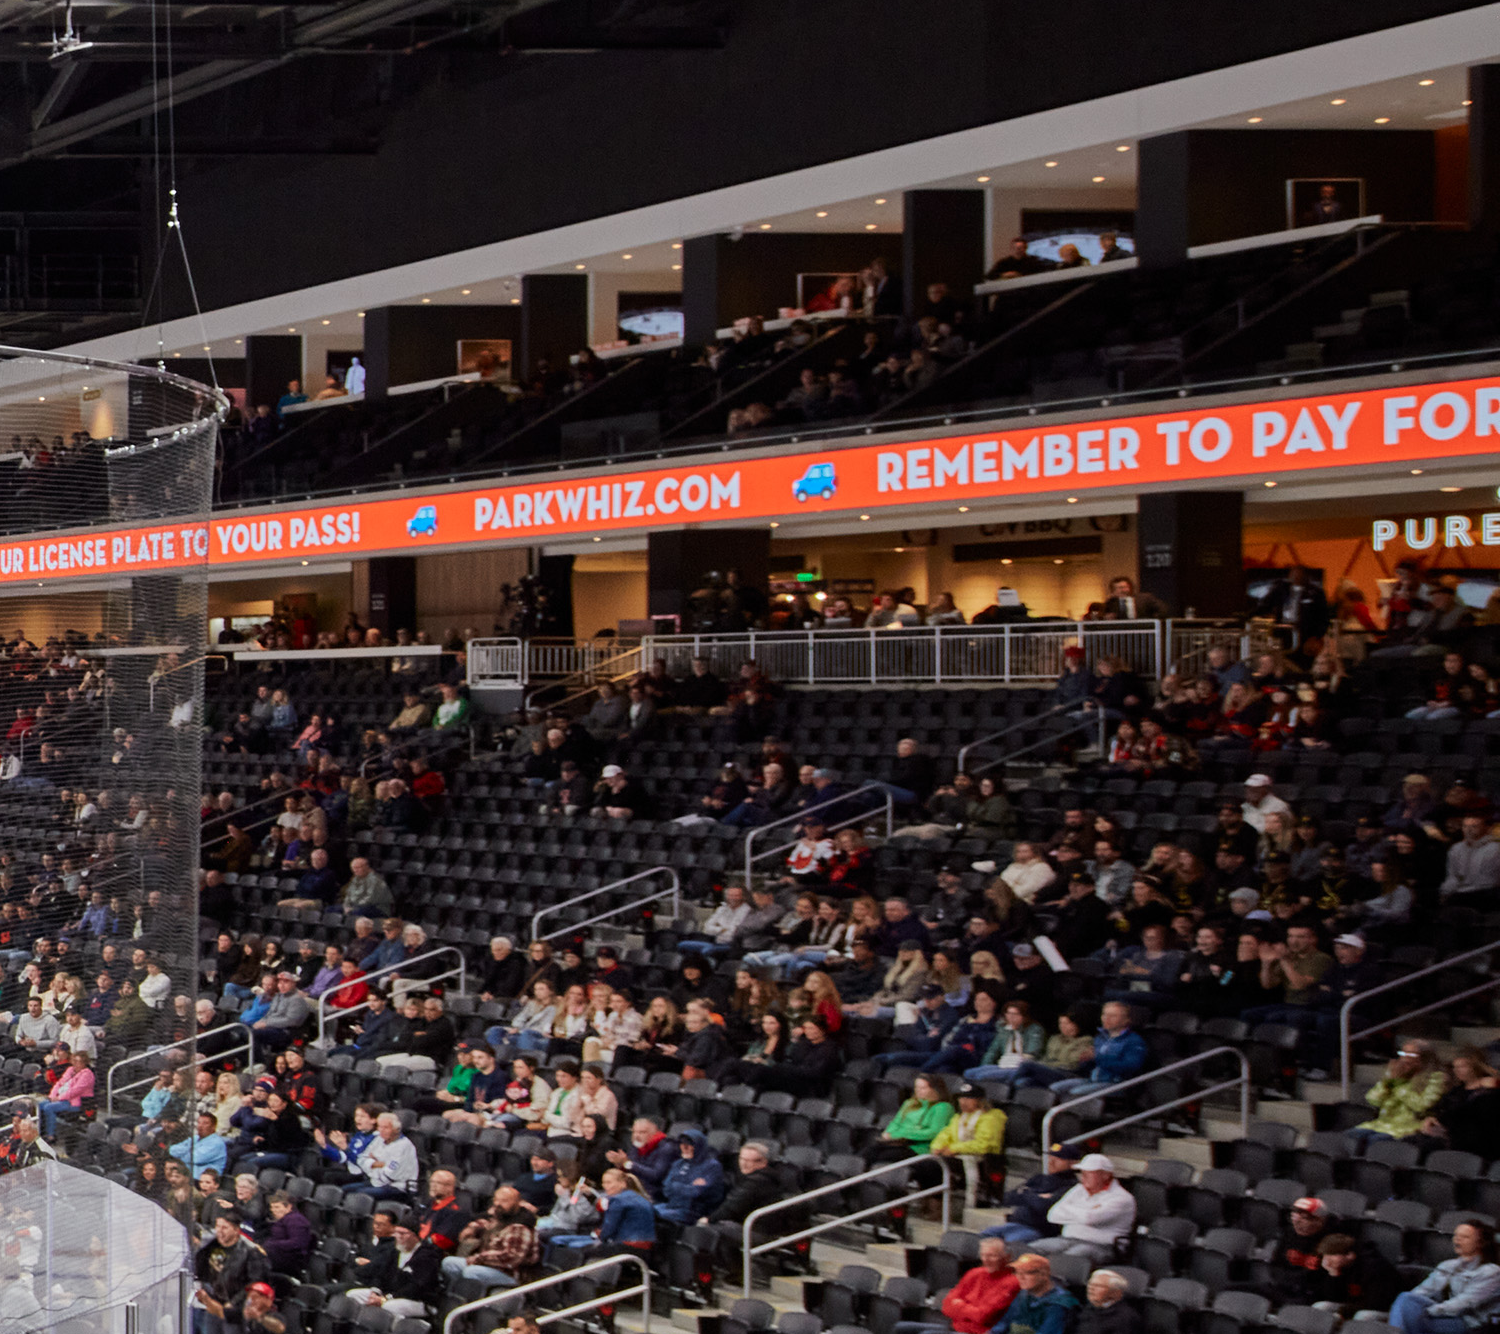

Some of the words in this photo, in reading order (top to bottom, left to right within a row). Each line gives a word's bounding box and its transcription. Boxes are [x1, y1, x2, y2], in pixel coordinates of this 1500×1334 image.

[878, 427, 1140, 492] REMEMBER
[1157, 418, 1233, 465] TO
[1252, 402, 1362, 457] PAY
[1384, 387, 1500, 444] FOR
[475, 472, 740, 530] PARKWHIZ.COM
[29, 539, 107, 571] LICENSE
[112, 532, 175, 563] PLATE
[181, 529, 209, 557] TO
[217, 521, 283, 554] YOUR
[291, 512, 360, 547] PASS!
[1372, 512, 1500, 552] PURE
